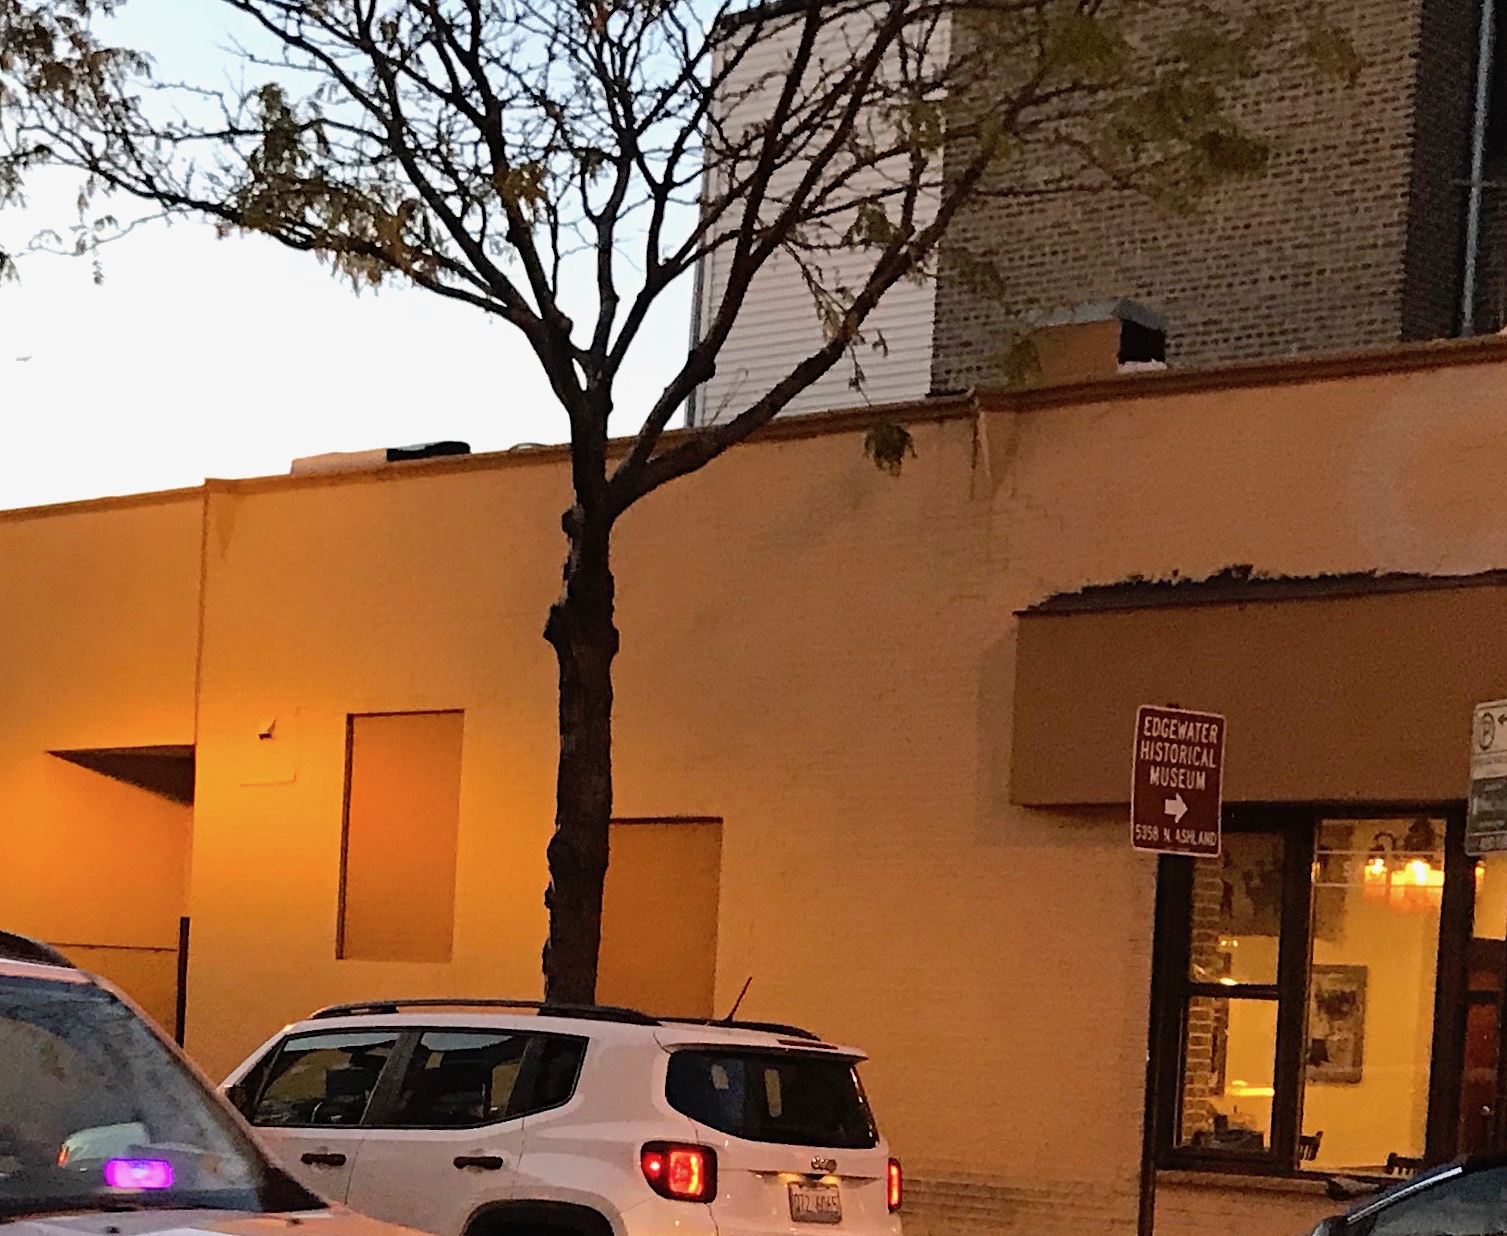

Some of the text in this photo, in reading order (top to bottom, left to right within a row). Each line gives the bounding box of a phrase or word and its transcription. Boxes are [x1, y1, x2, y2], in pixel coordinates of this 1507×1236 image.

[1143, 716, 1218, 744] EDGEWATER
[1140, 740, 1217, 768] HISTORICAL
[1149, 765, 1206, 790] MUSEUM
[1175, 828, 1216, 846] ASHLAND
